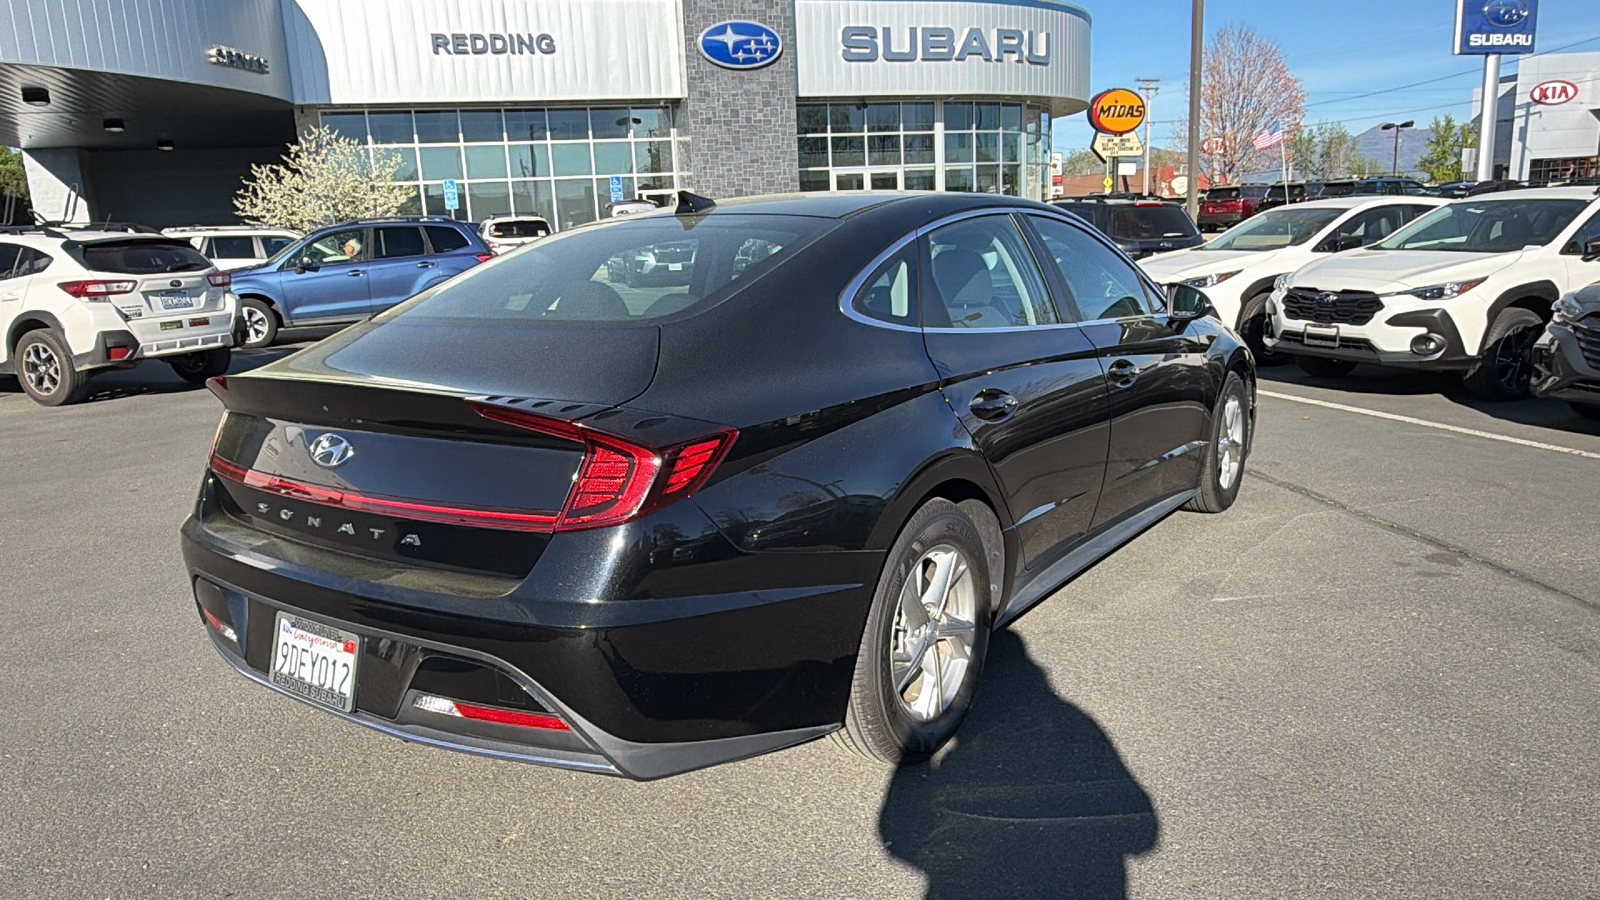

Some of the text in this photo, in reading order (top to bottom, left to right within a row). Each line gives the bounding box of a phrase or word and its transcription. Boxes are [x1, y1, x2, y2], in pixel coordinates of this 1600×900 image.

[430, 33, 556, 55] REDDING
[842, 26, 1050, 66] SUBARU
[1469, 33, 1533, 46] SUBARU
[1538, 85, 1570, 101] KIA
[1098, 101, 1143, 118] MIDAS
[257, 502, 421, 546] SONATA
[279, 641, 350, 696] 9DEY012
[274, 672, 345, 708] REDDING SUBARU
